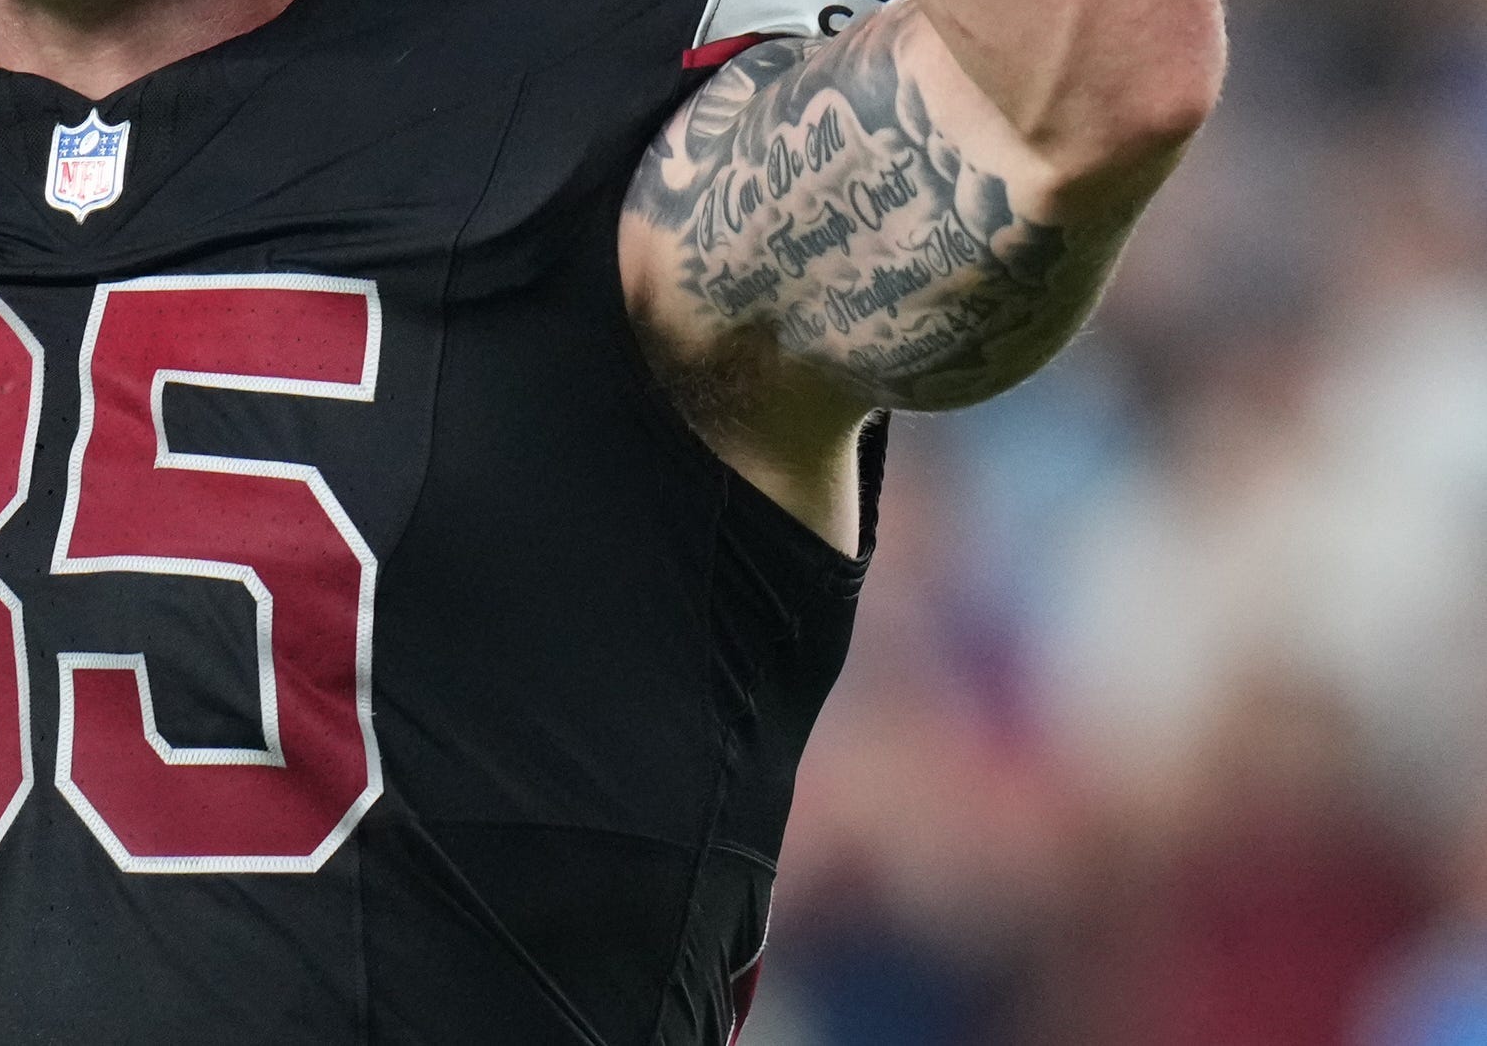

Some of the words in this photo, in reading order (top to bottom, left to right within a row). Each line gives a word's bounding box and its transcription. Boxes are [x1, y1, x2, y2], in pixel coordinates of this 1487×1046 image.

[58, 160, 110, 200] NFL
[723, 170, 764, 234] Can
[767, 135, 804, 200] Do
[849, 151, 918, 232] Christ
